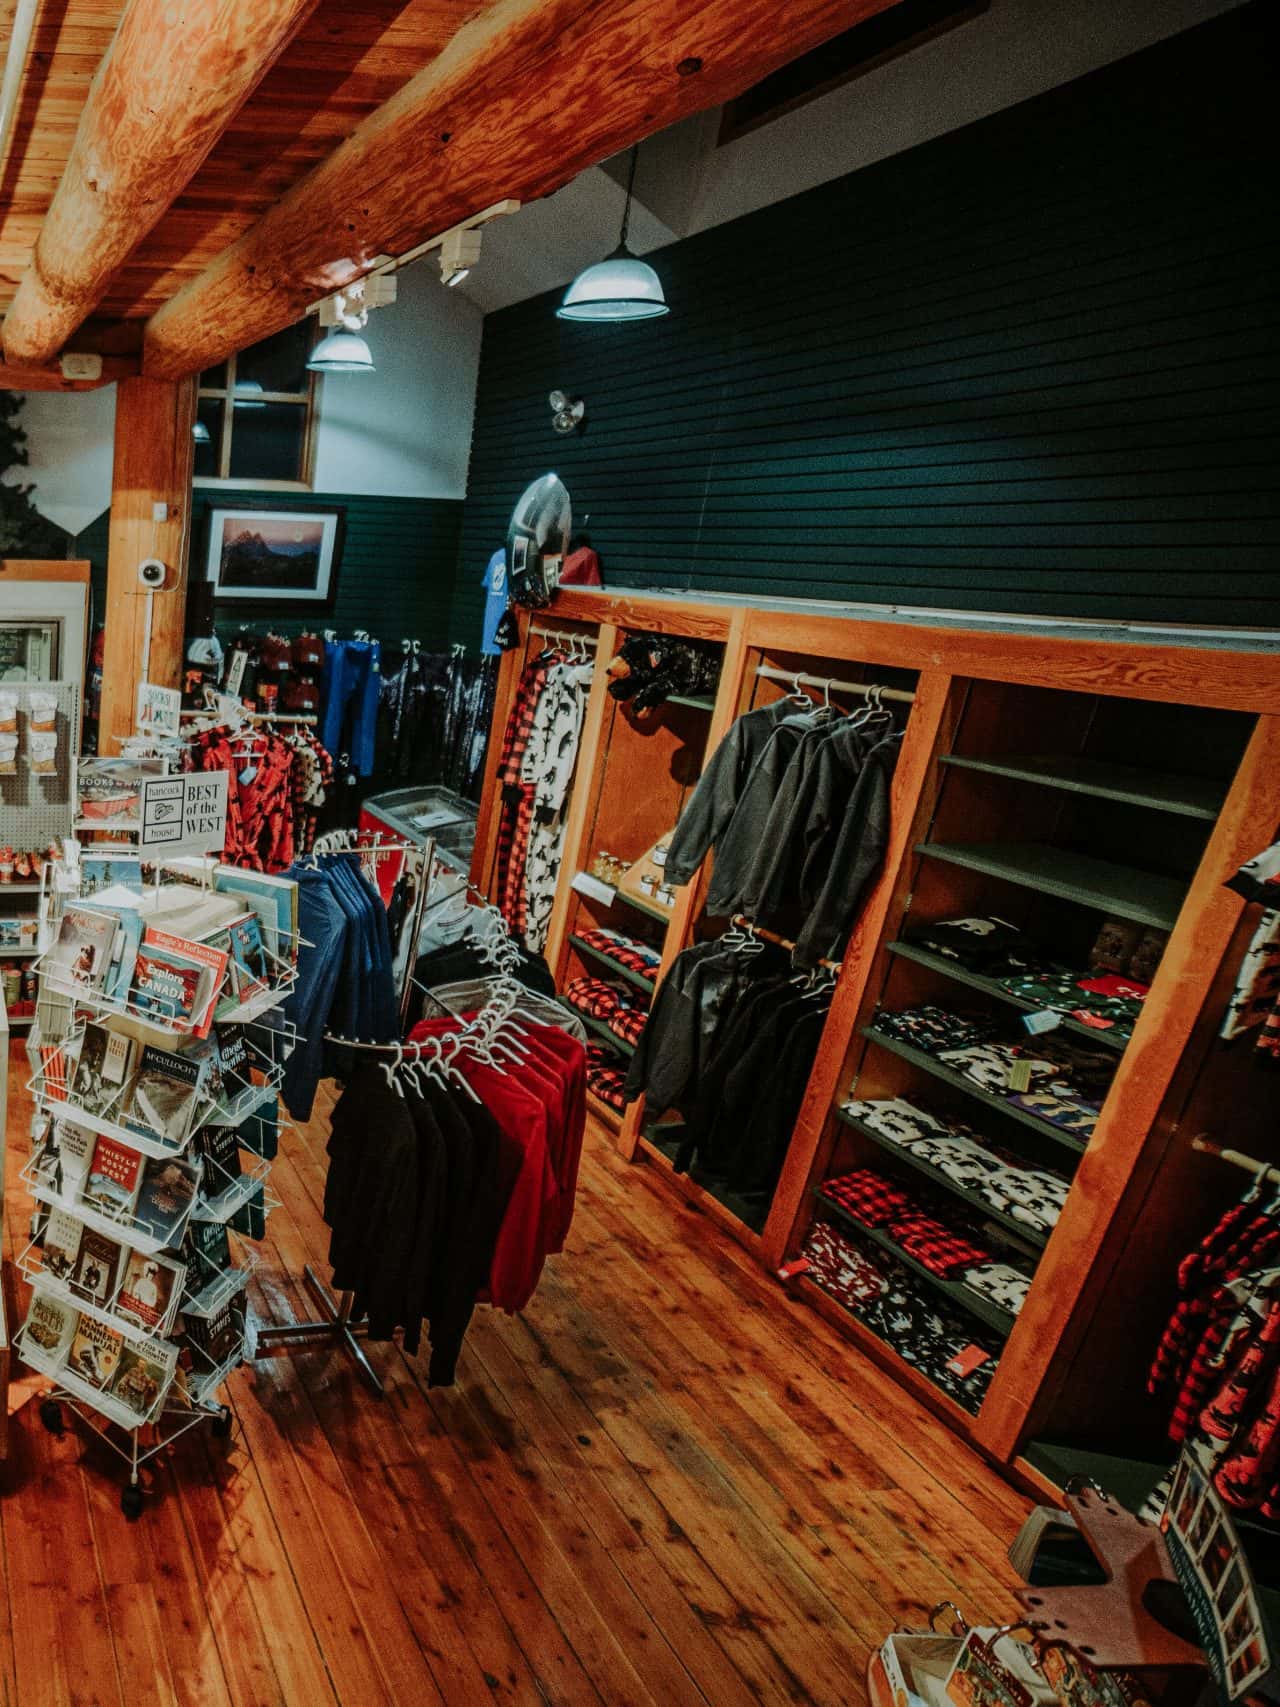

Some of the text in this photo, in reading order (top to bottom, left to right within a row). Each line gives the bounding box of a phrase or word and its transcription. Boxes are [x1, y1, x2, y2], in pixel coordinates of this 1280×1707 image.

[79, 777, 115, 788] BOOKS
[149, 783, 181, 796] hancock
[188, 784, 220, 801] BEST
[186, 801, 218, 816] of the
[151, 825, 175, 837] house
[186, 817, 223, 833] WEST
[183, 943, 222, 961] Reflection
[147, 963, 185, 985] Explore
[138, 976, 186, 1002] CANADA
[98, 1145, 138, 1168] WHISTLE
[102, 1156, 130, 1174] POSTS
[101, 1166, 126, 1181] WEST
[78, 1326, 119, 1356] MANUAL
